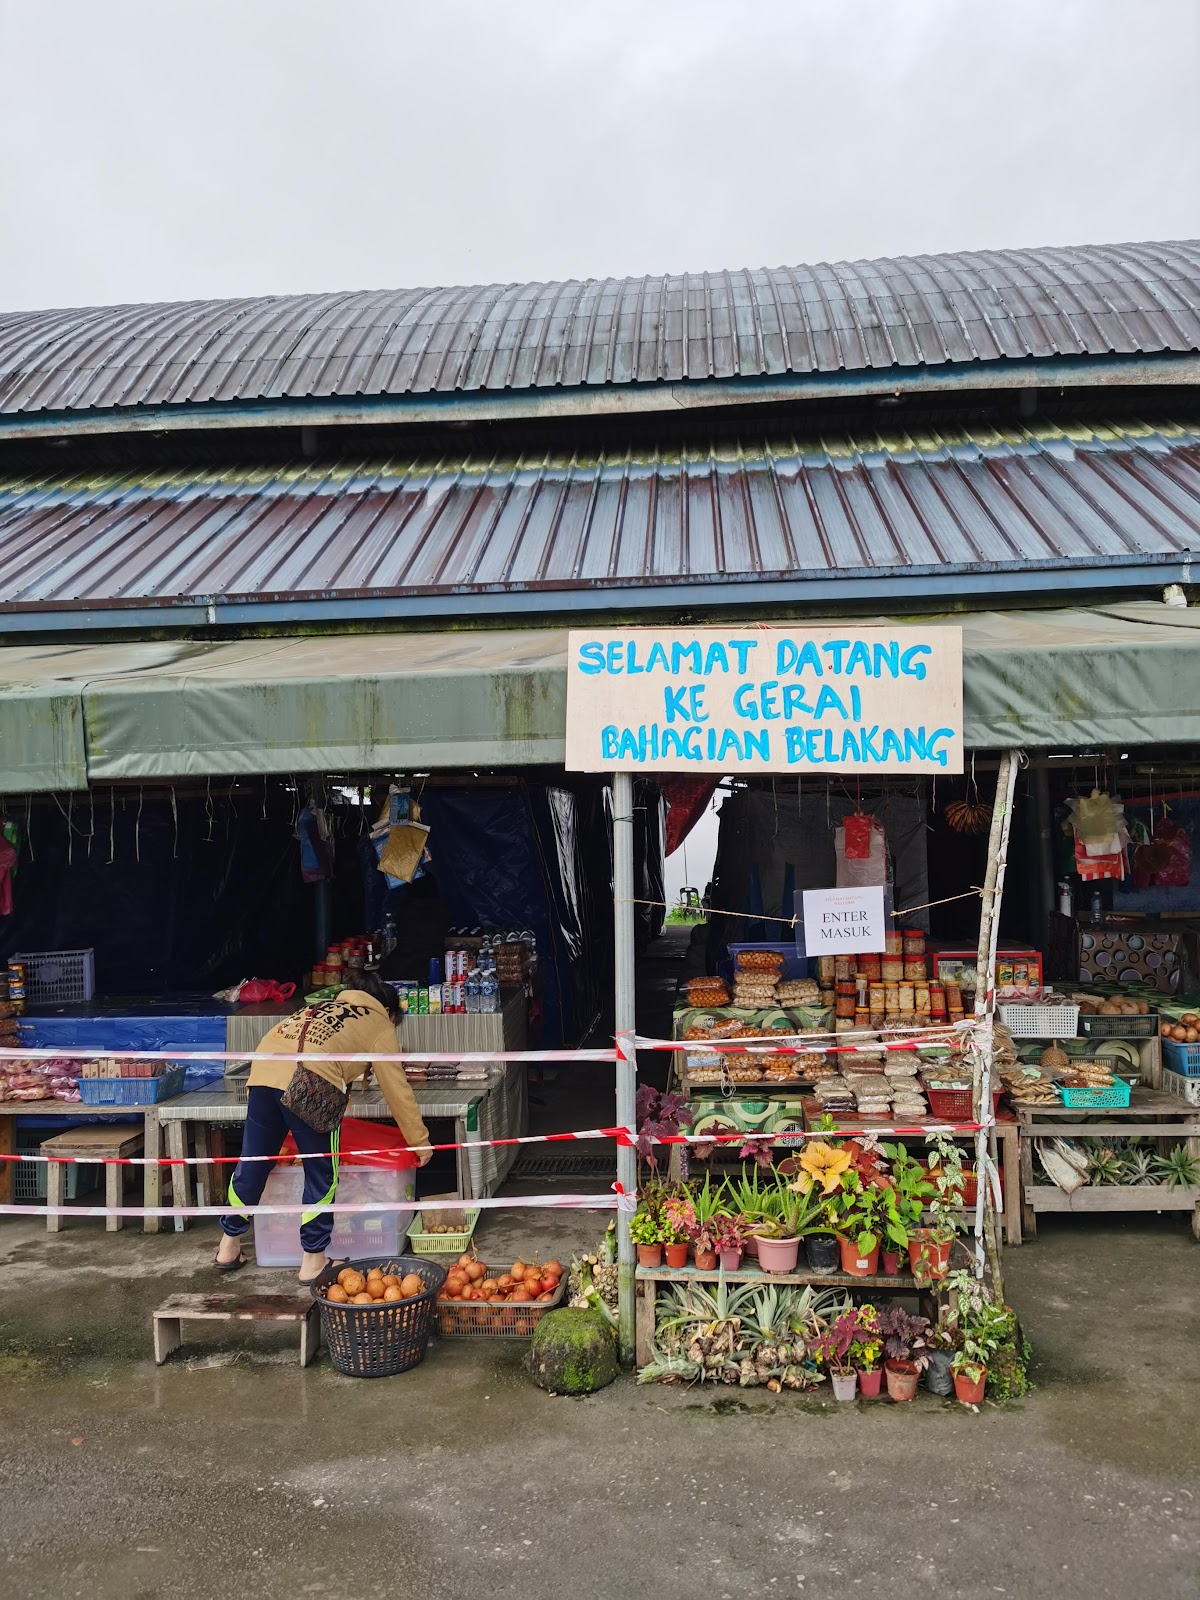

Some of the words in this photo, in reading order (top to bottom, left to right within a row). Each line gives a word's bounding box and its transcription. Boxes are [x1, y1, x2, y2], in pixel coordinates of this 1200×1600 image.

[577, 640, 757, 675] SELAMAT
[776, 639, 932, 680] DATANG
[664, 684, 709, 723] KE
[733, 681, 862, 721] GERAI
[601, 723, 770, 763] BAHAGIAN
[784, 725, 956, 767] BELAKANG
[822, 910, 869, 923] ENTER
[820, 926, 872, 939] MASUK
[311, 1020, 336, 1035] LITTLE
[312, 1026, 334, 1038] WITH
[305, 1030, 329, 1041] REAT
